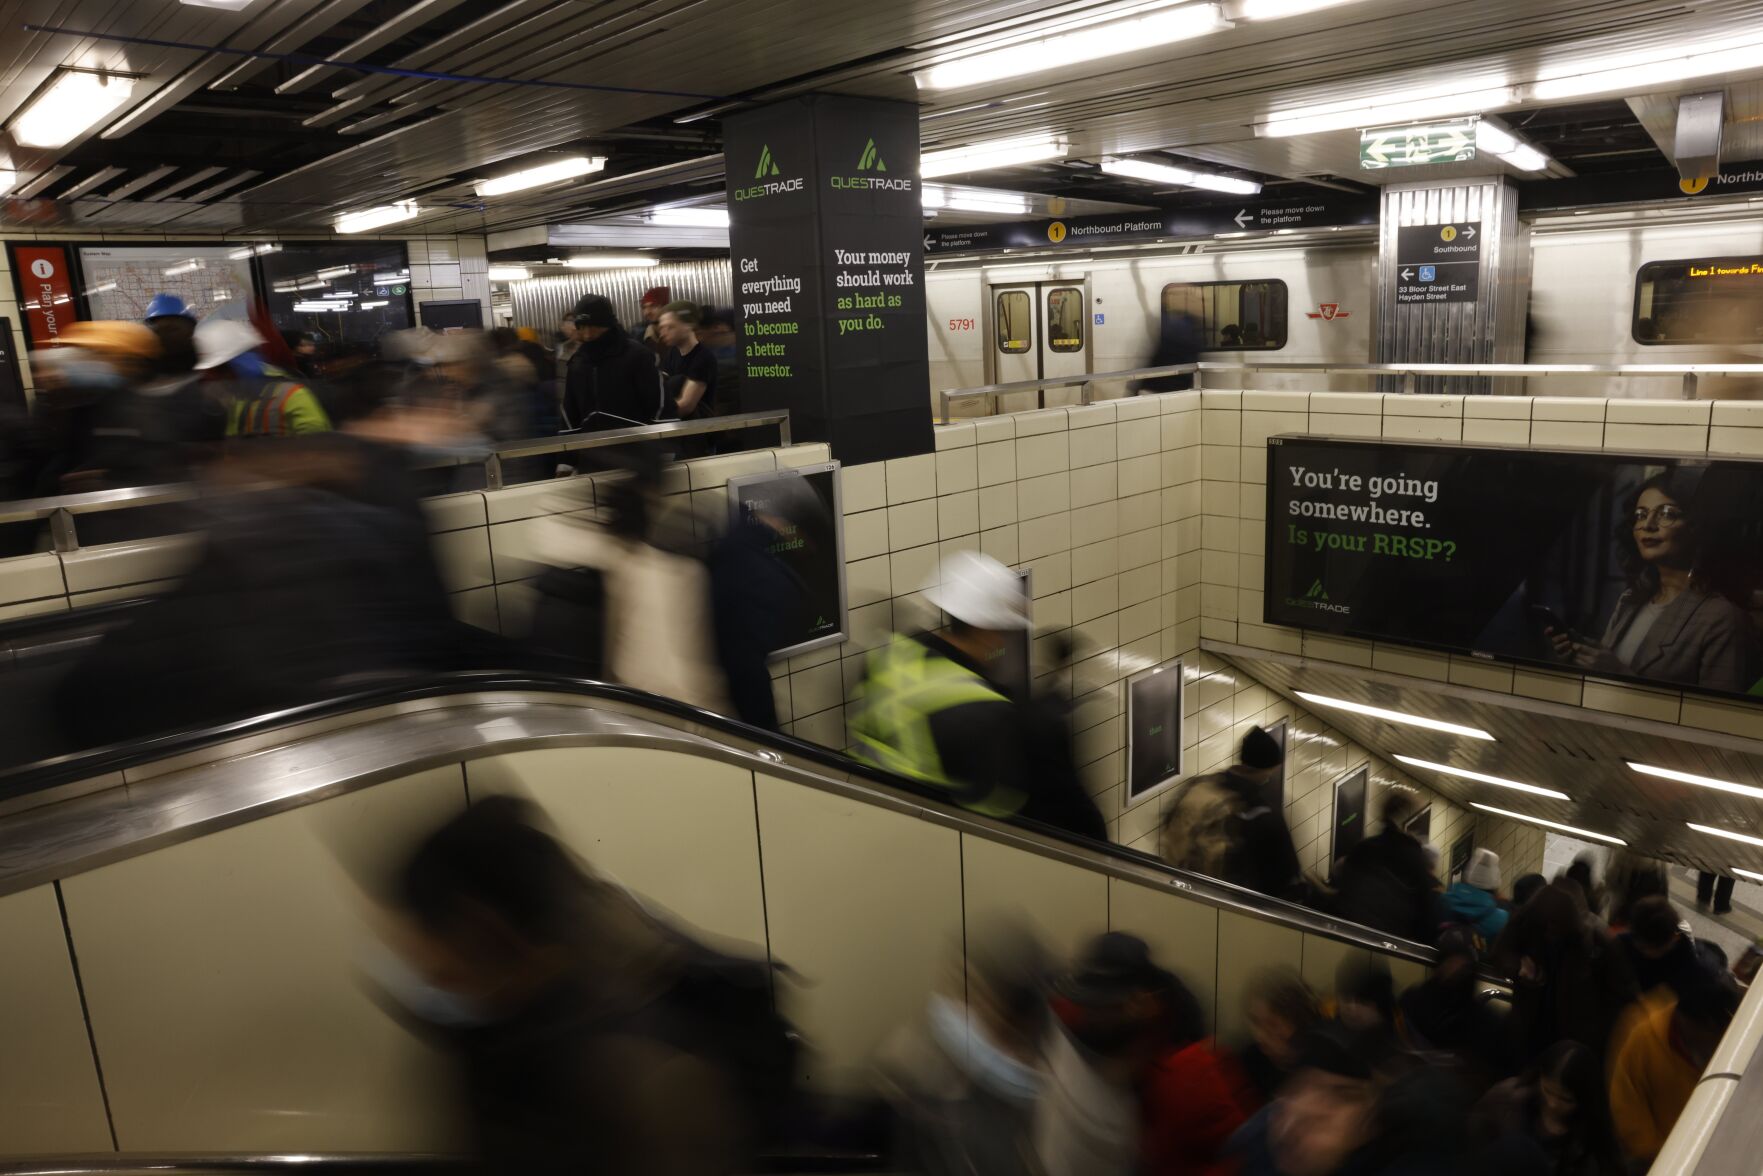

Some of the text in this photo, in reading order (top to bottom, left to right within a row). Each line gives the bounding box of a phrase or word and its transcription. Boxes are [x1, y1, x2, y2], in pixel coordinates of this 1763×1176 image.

[830, 175, 912, 191] QUESTRADE
[1716, 170, 1763, 185] Northb
[734, 177, 804, 201] QUESTRADE
[1260, 208, 1284, 216] Please
[1305, 205, 1325, 213] down
[1272, 215, 1302, 225] platform
[941, 232, 957, 240] Please
[1071, 224, 1122, 236] Northbound
[1124, 221, 1162, 232] Platform
[950, 240, 971, 248] platform
[1433, 245, 1477, 254] Southbound
[740, 258, 759, 273] Get
[834, 249, 911, 268] Your money
[836, 269, 914, 287] should work
[1690, 266, 1708, 277] Line
[1717, 266, 1749, 275] towards
[741, 274, 801, 296] everything
[1408, 285, 1427, 293] Bloor
[40, 283, 53, 308] Plan
[837, 291, 902, 310] as hard as
[1398, 294, 1425, 302] Hayden
[743, 296, 792, 319] you need
[42, 310, 58, 335] your
[744, 320, 799, 336] to become
[838, 313, 885, 336] you do.
[949, 318, 975, 331] 5791
[746, 341, 786, 357] a better
[747, 362, 793, 377] investor.
[1289, 466, 1439, 503] You're going
[1289, 499, 1431, 529] somewhere.
[1287, 524, 1457, 562] Is your RRSP?
